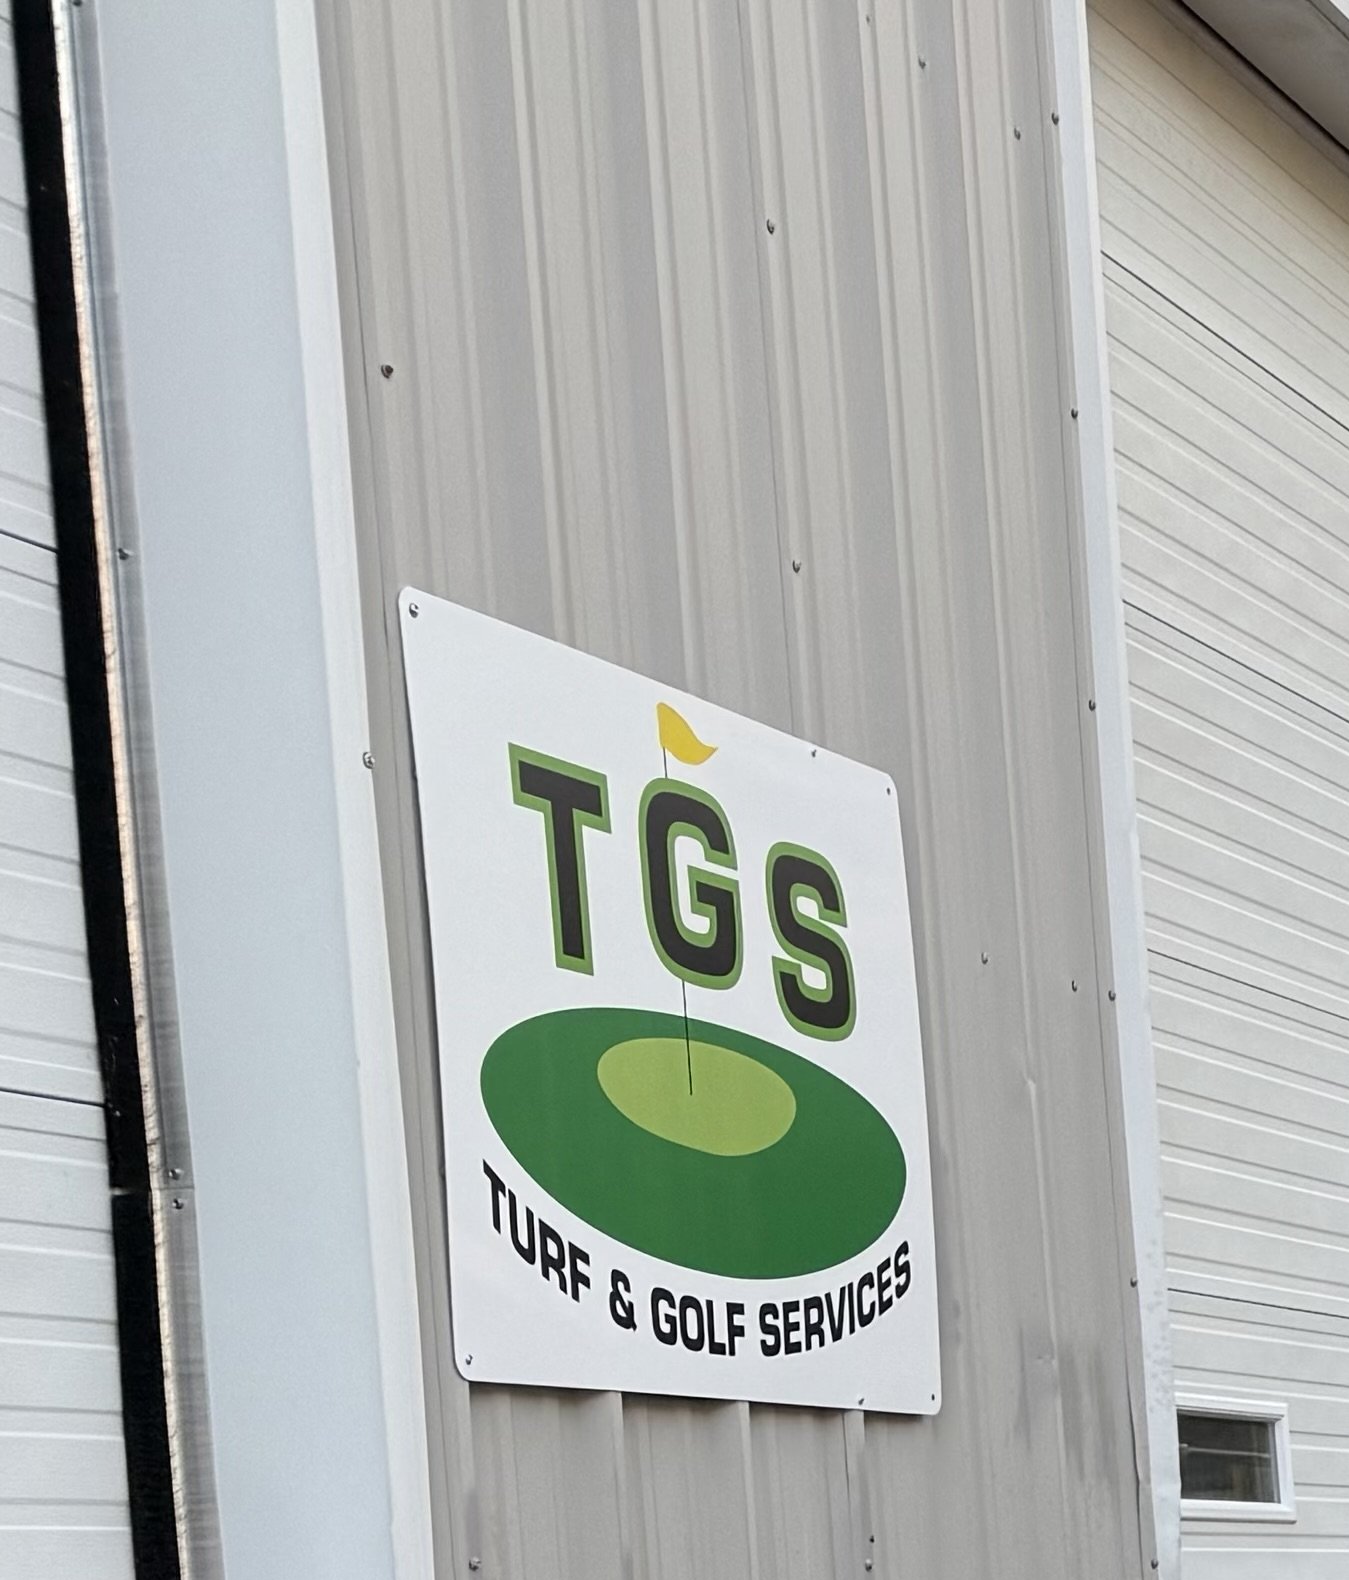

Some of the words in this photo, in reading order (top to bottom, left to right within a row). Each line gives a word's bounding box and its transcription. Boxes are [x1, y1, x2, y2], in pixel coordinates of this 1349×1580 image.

[508, 741, 856, 1042] TGS
[482, 1159, 591, 1303] TURF
[609, 1268, 637, 1332] &
[650, 1286, 745, 1357] GOLF
[759, 1240, 912, 1357] SERVICES
